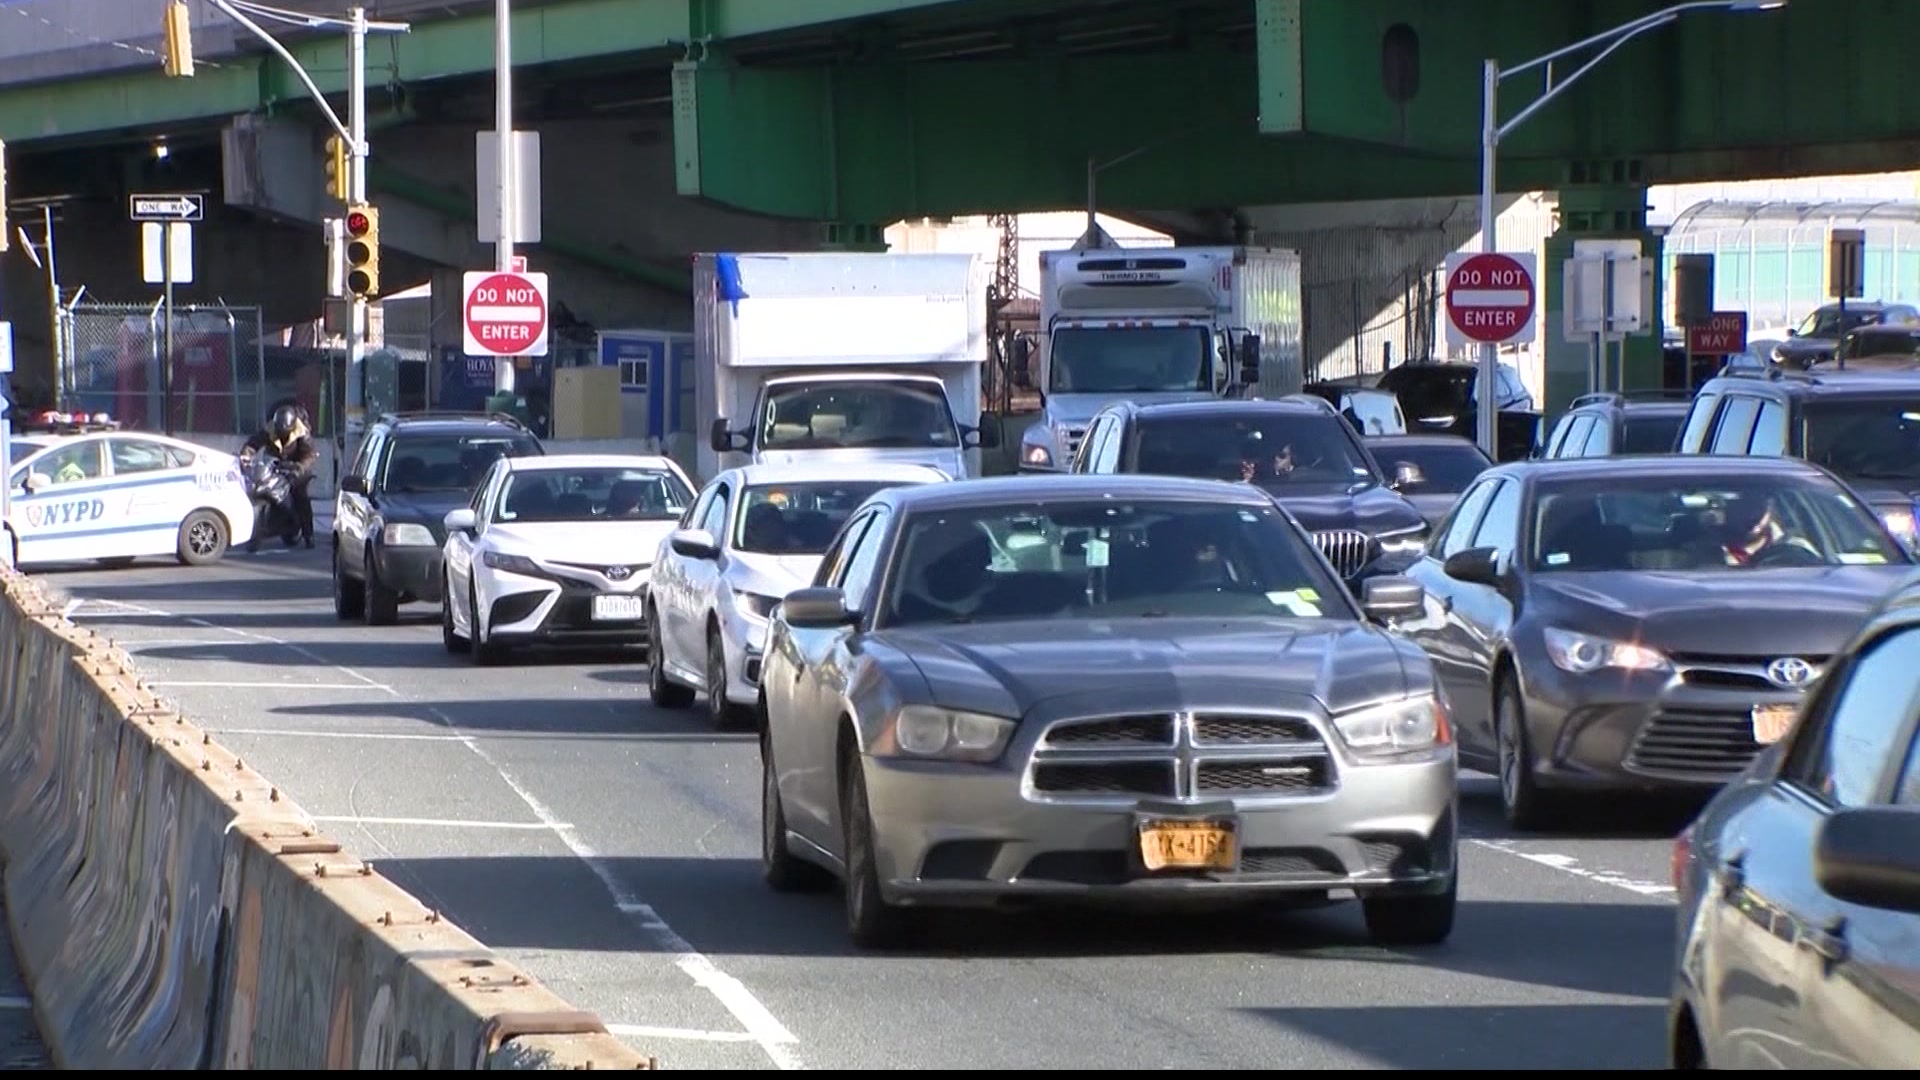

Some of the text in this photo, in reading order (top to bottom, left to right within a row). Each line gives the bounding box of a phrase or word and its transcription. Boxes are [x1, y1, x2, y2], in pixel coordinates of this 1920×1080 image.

[170, 203, 190, 212] WAY
[1101, 272, 1138, 280] THERMO
[1459, 270, 1522, 285] DO NOT
[477, 288, 536, 303] DO NOT
[1464, 311, 1516, 326] ENTER
[482, 325, 529, 339] ENTER
[1700, 334, 1729, 347] WAY
[43, 499, 104, 525] NYPD
